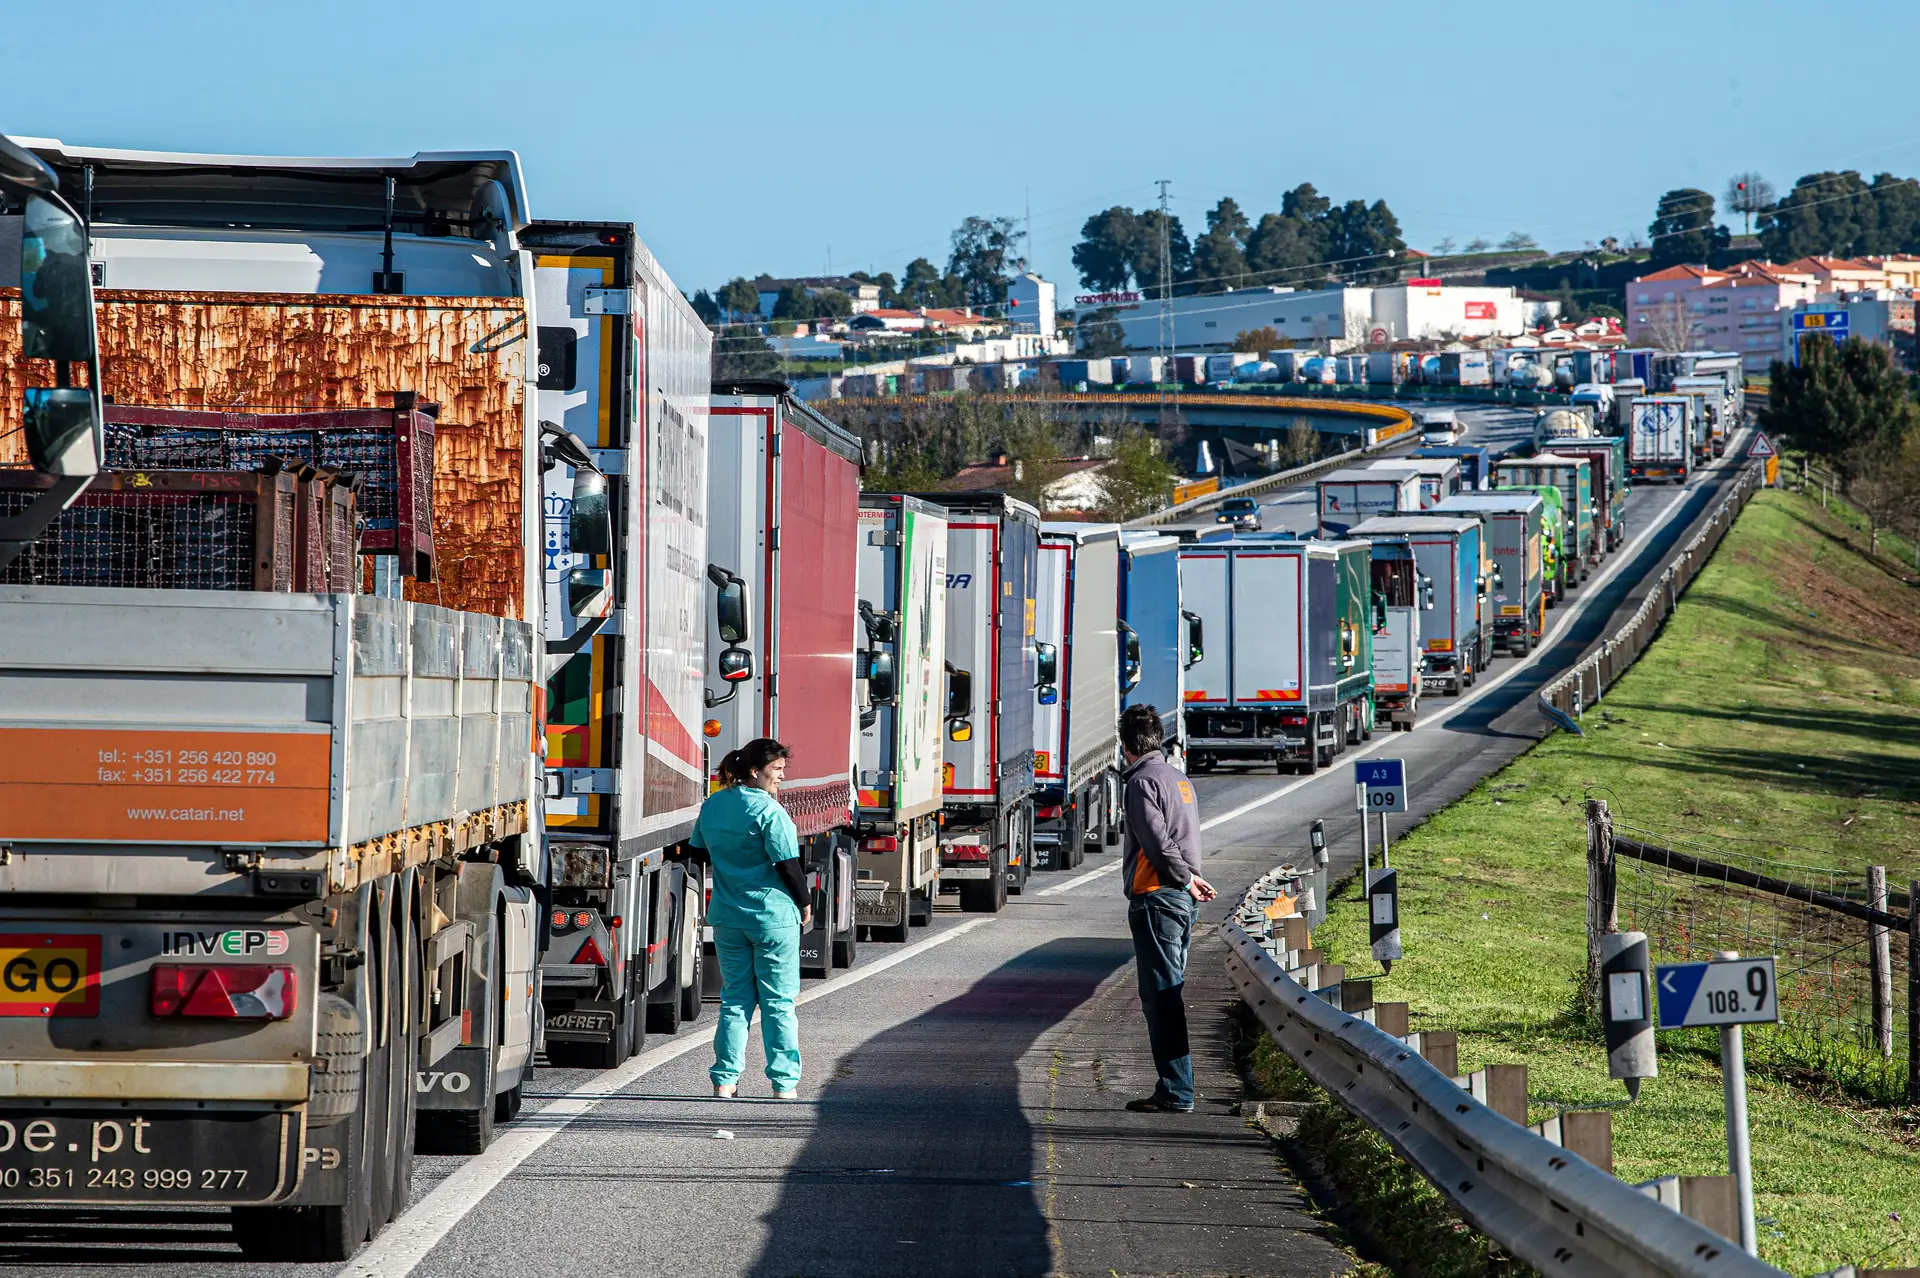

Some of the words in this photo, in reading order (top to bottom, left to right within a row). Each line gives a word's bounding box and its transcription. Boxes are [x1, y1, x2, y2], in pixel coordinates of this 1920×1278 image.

[1809, 315, 1820, 326] 15
[98, 749, 126, 763] tel.:
[132, 750, 172, 764] +351
[178, 751, 208, 765] 256
[212, 751, 242, 765] 420
[246, 752, 276, 766] 890
[98, 767, 126, 781] fax:
[132, 768, 172, 782] +351
[178, 769, 208, 783] 256
[212, 770, 242, 783] 422
[246, 770, 276, 783] 774
[1366, 792, 1394, 806] 109
[127, 807, 244, 821] www.catari.net
[800, 949, 818, 958] CKS
[3, 957, 80, 993] GO
[28, 1168, 73, 1187] 351
[87, 1168, 135, 1188] 243
[143, 1169, 191, 1189] 999
[199, 1169, 248, 1189] 277
